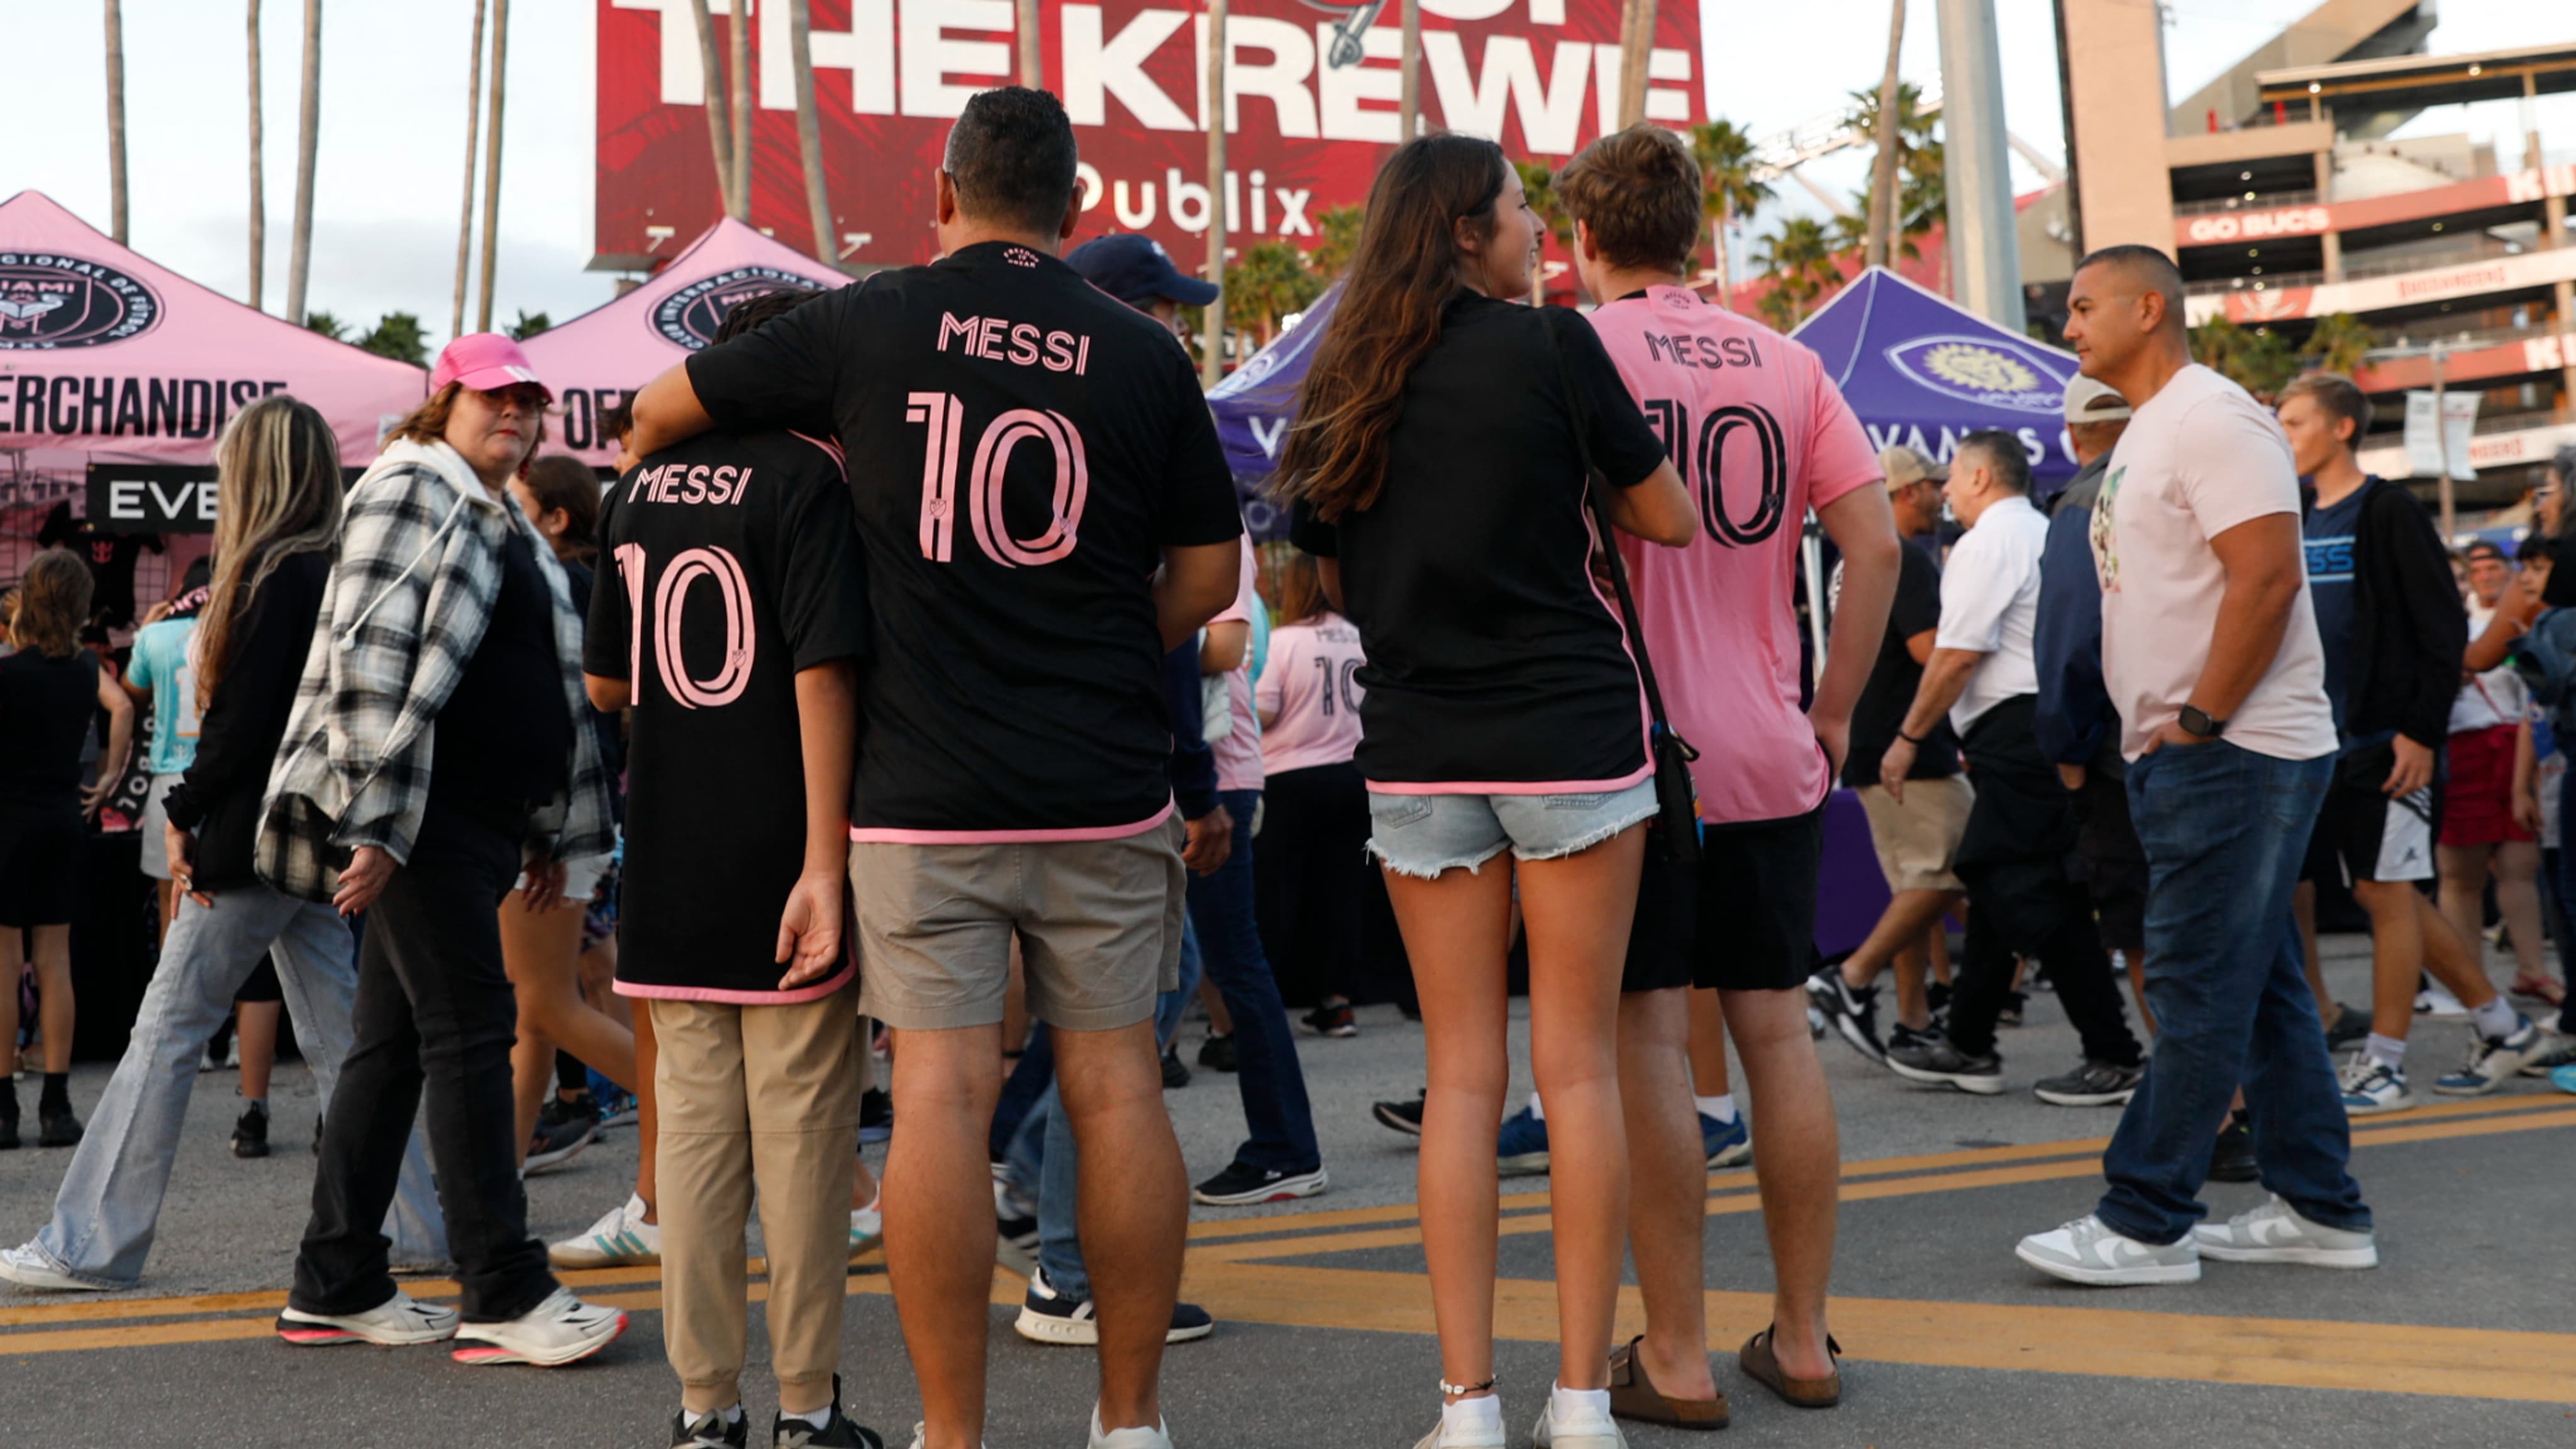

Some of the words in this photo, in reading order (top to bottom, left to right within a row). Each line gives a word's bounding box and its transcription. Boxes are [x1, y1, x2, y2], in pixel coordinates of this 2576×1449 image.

[612, 0, 1014, 119] THE
[1061, 3, 1692, 155] KREWE
[2189, 217, 2240, 242] GO
[2241, 207, 2331, 237] BUCS
[936, 311, 1090, 375] MESSI
[1643, 330, 1763, 370] MESSI
[0, 374, 287, 440] ERCHANDIS
[628, 464, 753, 506] MESSI
[906, 391, 1089, 569] 10
[1643, 399, 1787, 550] 10
[613, 541, 755, 710] 10
